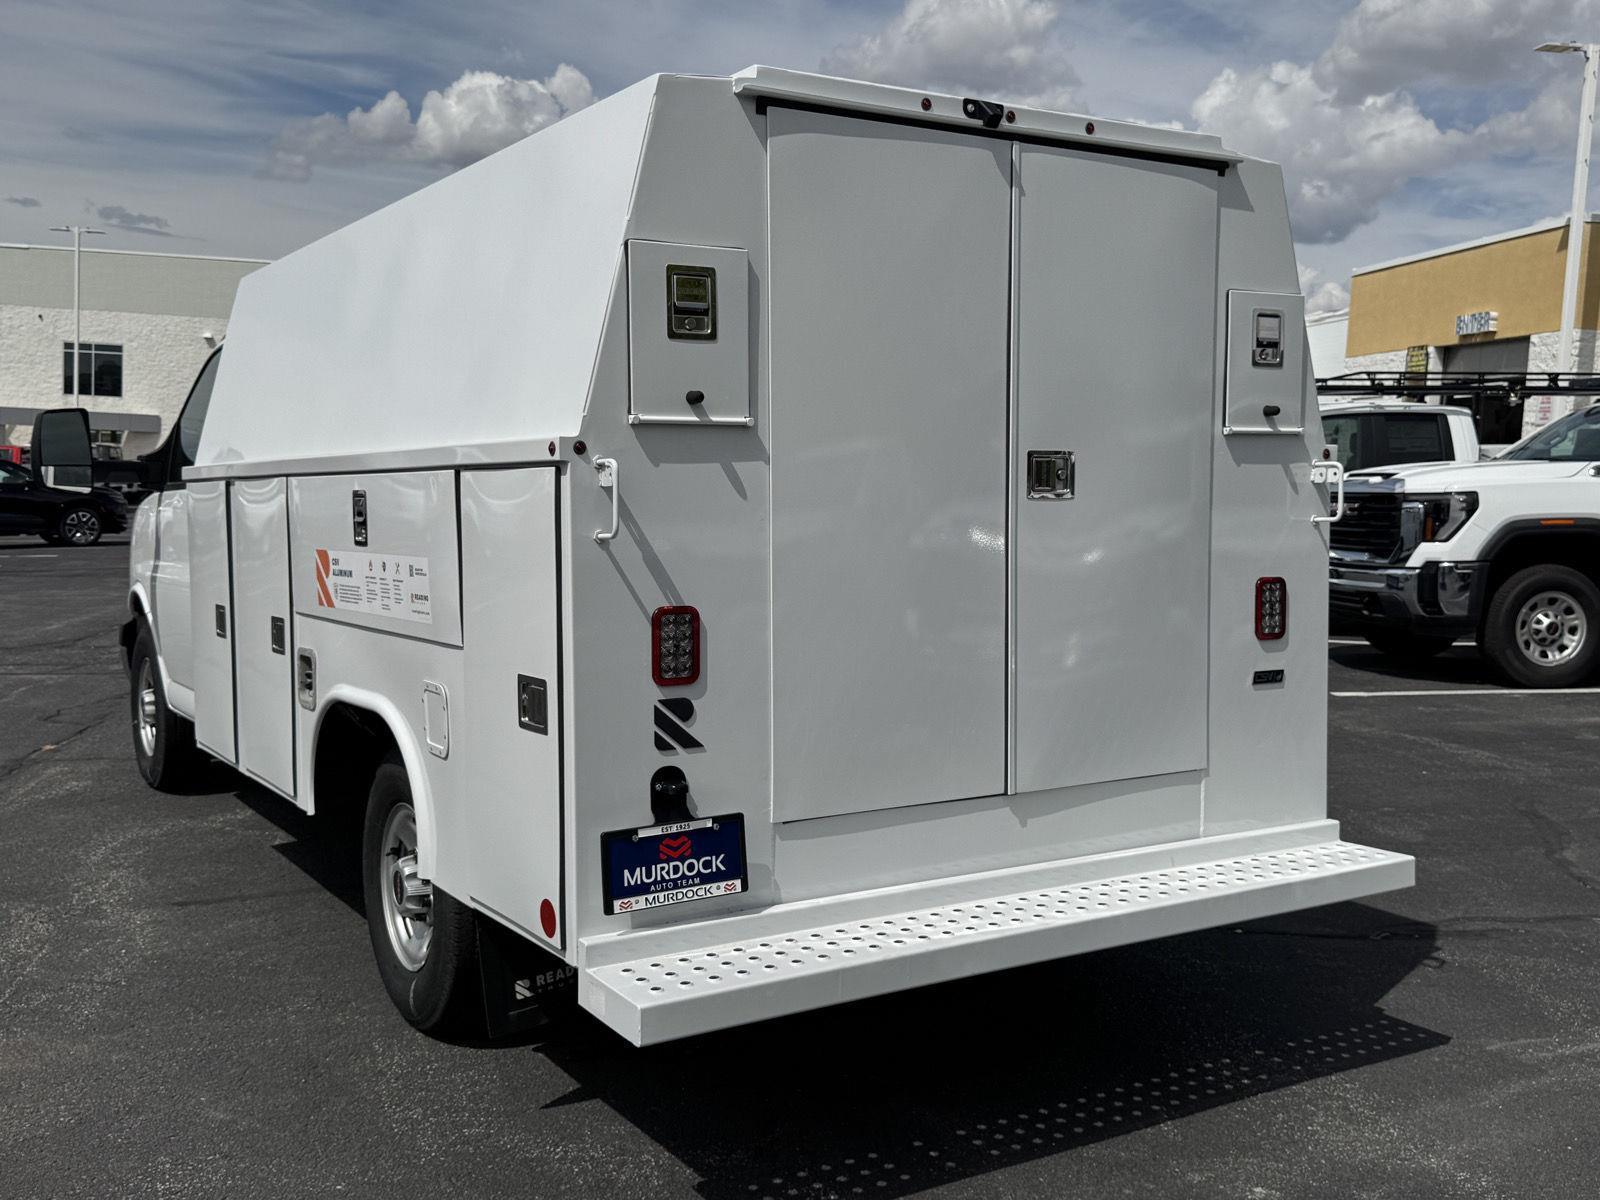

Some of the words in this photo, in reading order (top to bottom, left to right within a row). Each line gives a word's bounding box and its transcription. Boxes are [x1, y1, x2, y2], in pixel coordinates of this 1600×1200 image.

[661, 825, 675, 833] EST.
[675, 823, 691, 831] 1925
[623, 853, 726, 887] MURDOCK
[650, 881, 674, 892] AUTO
[678, 877, 700, 887] TEAM
[645, 886, 713, 907] MURDOCK
[536, 966, 575, 987] READ
